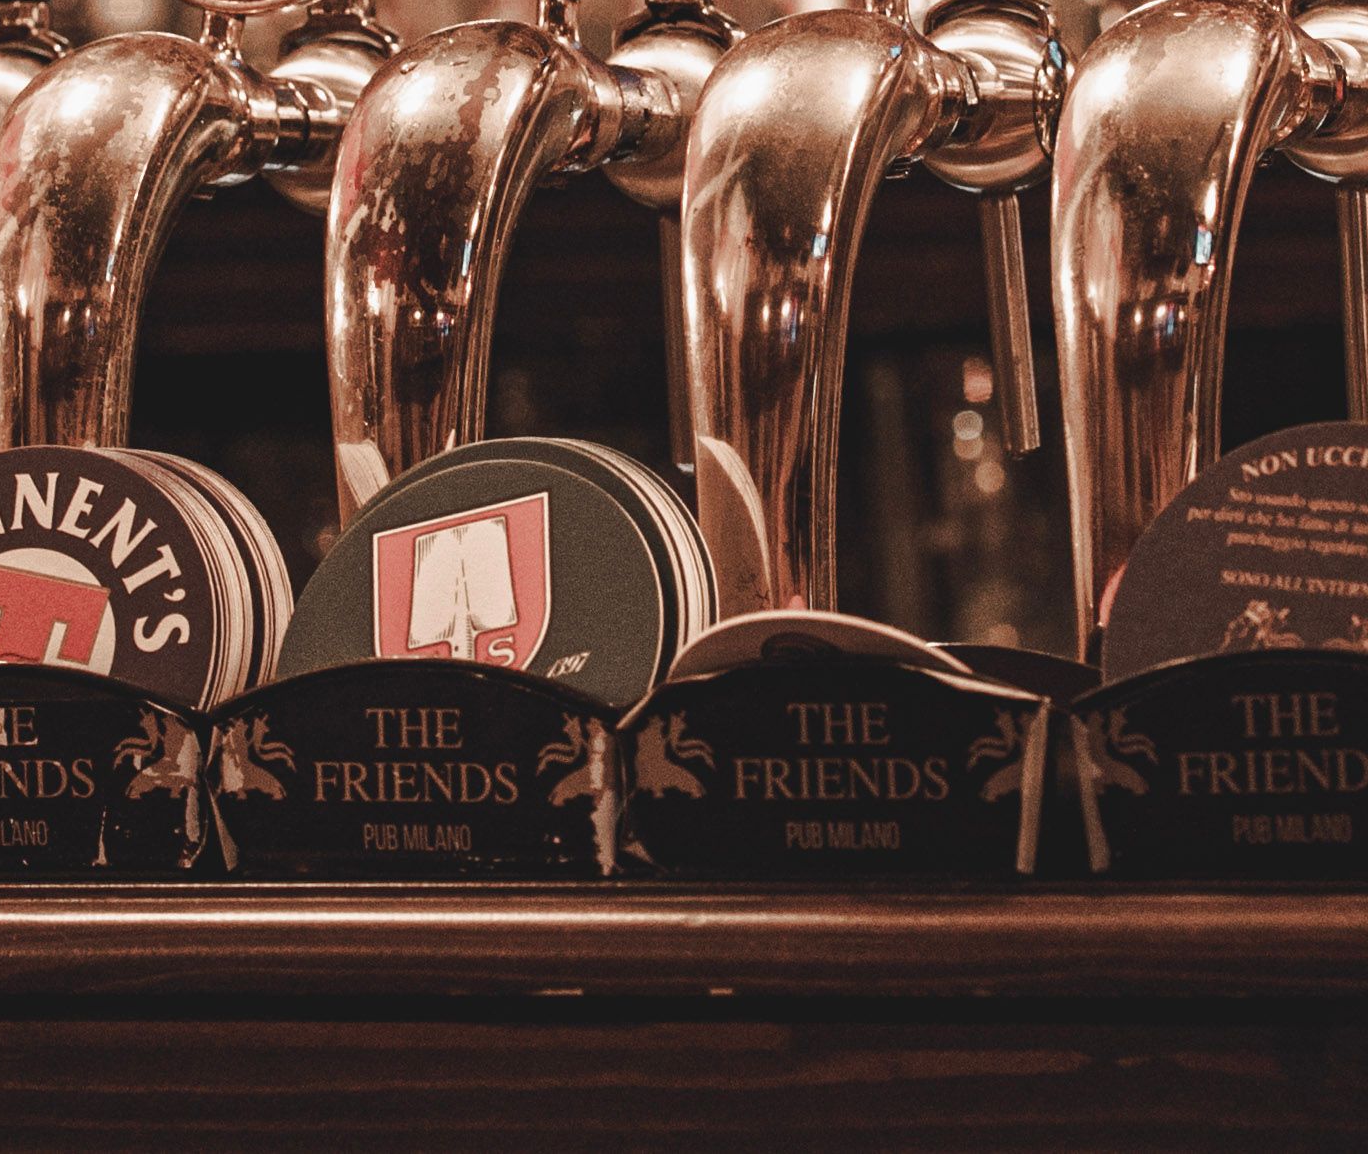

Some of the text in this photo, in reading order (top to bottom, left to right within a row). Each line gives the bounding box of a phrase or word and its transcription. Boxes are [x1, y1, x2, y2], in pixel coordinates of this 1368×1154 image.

[1241, 449, 1299, 483] NON
[487, 635, 516, 668] S
[365, 707, 463, 750] THE
[786, 702, 892, 746] THE
[1232, 692, 1340, 738] THE
[312, 761, 520, 805] FRIENDS
[733, 757, 951, 802] FRIENDS
[363, 823, 472, 853] PUB MILANO
[785, 820, 902, 850] PUB MILANO
